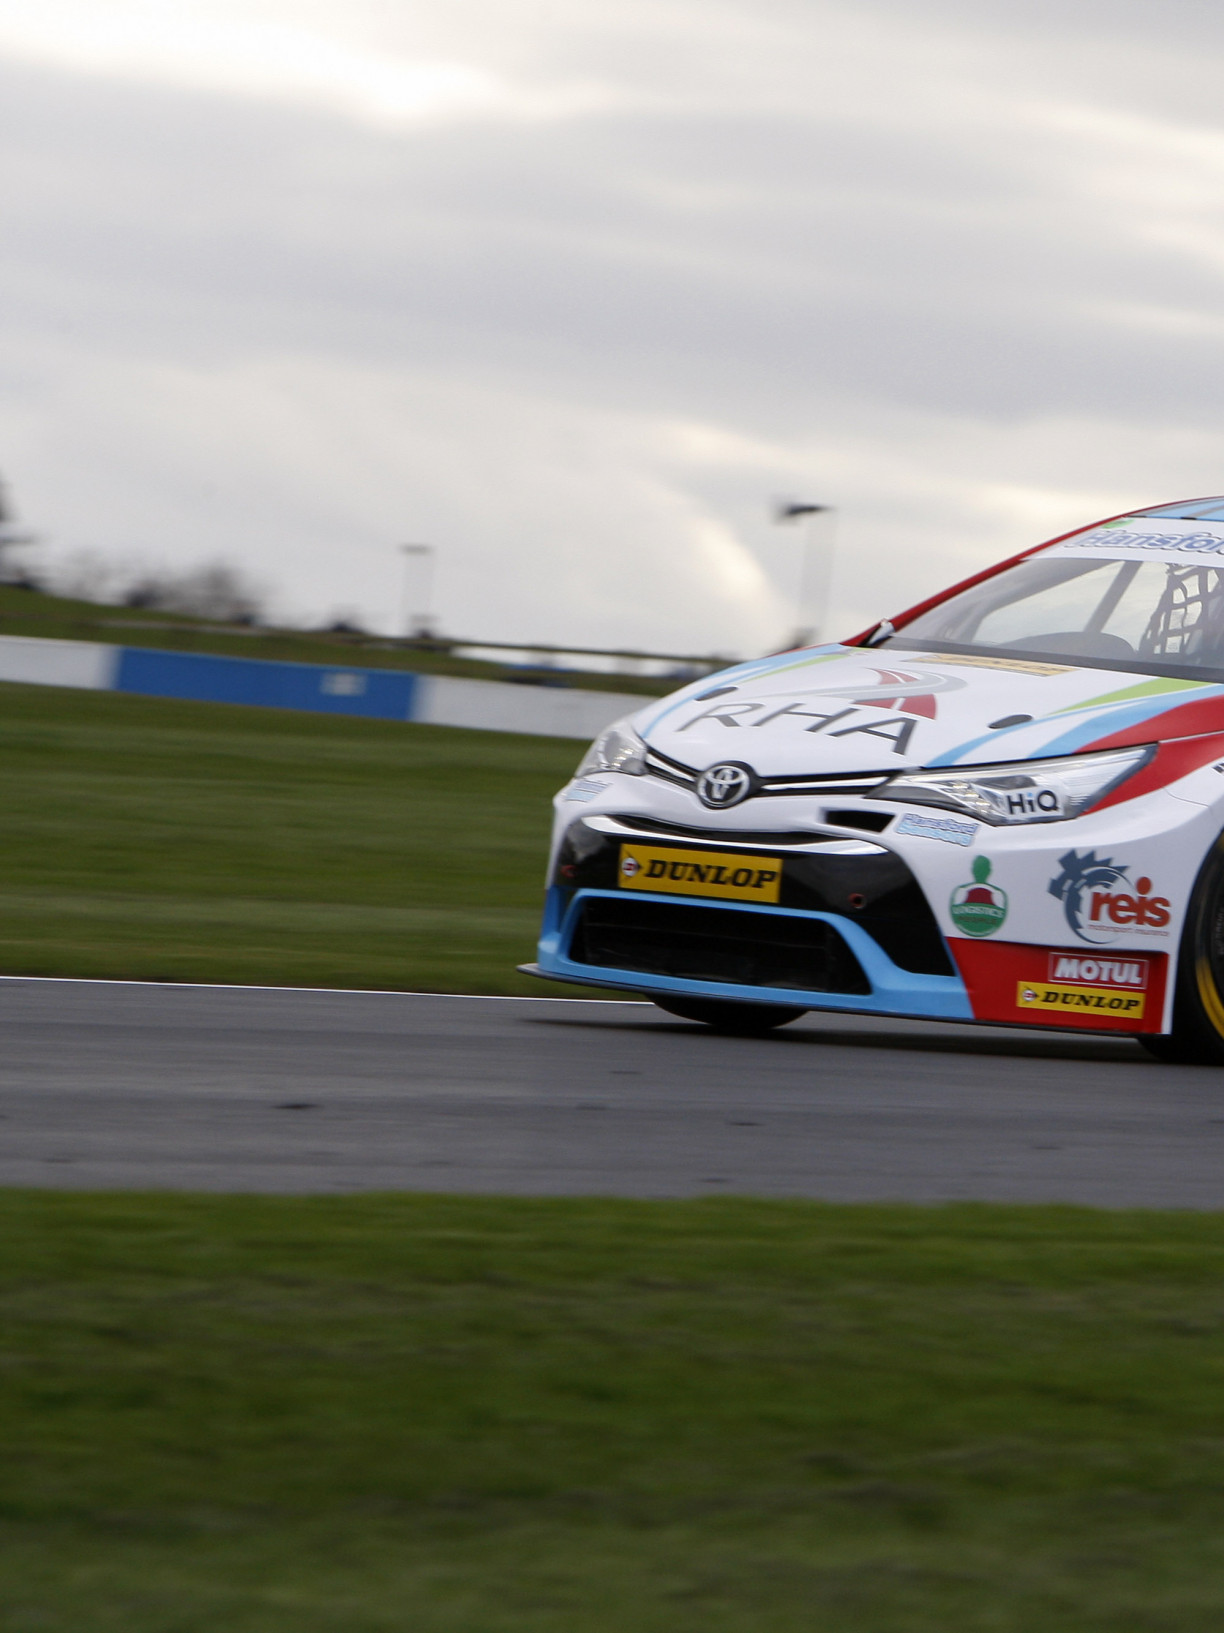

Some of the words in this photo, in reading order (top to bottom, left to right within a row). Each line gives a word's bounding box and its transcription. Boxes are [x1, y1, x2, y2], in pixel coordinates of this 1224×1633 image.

[675, 702, 918, 755] RHA
[1006, 789, 1059, 815] HiQ
[645, 859, 778, 888] DUNLOP
[1089, 876, 1171, 927] reis
[1054, 958, 1142, 984] MOTUL
[1043, 990, 1140, 1012] DUNLOP
